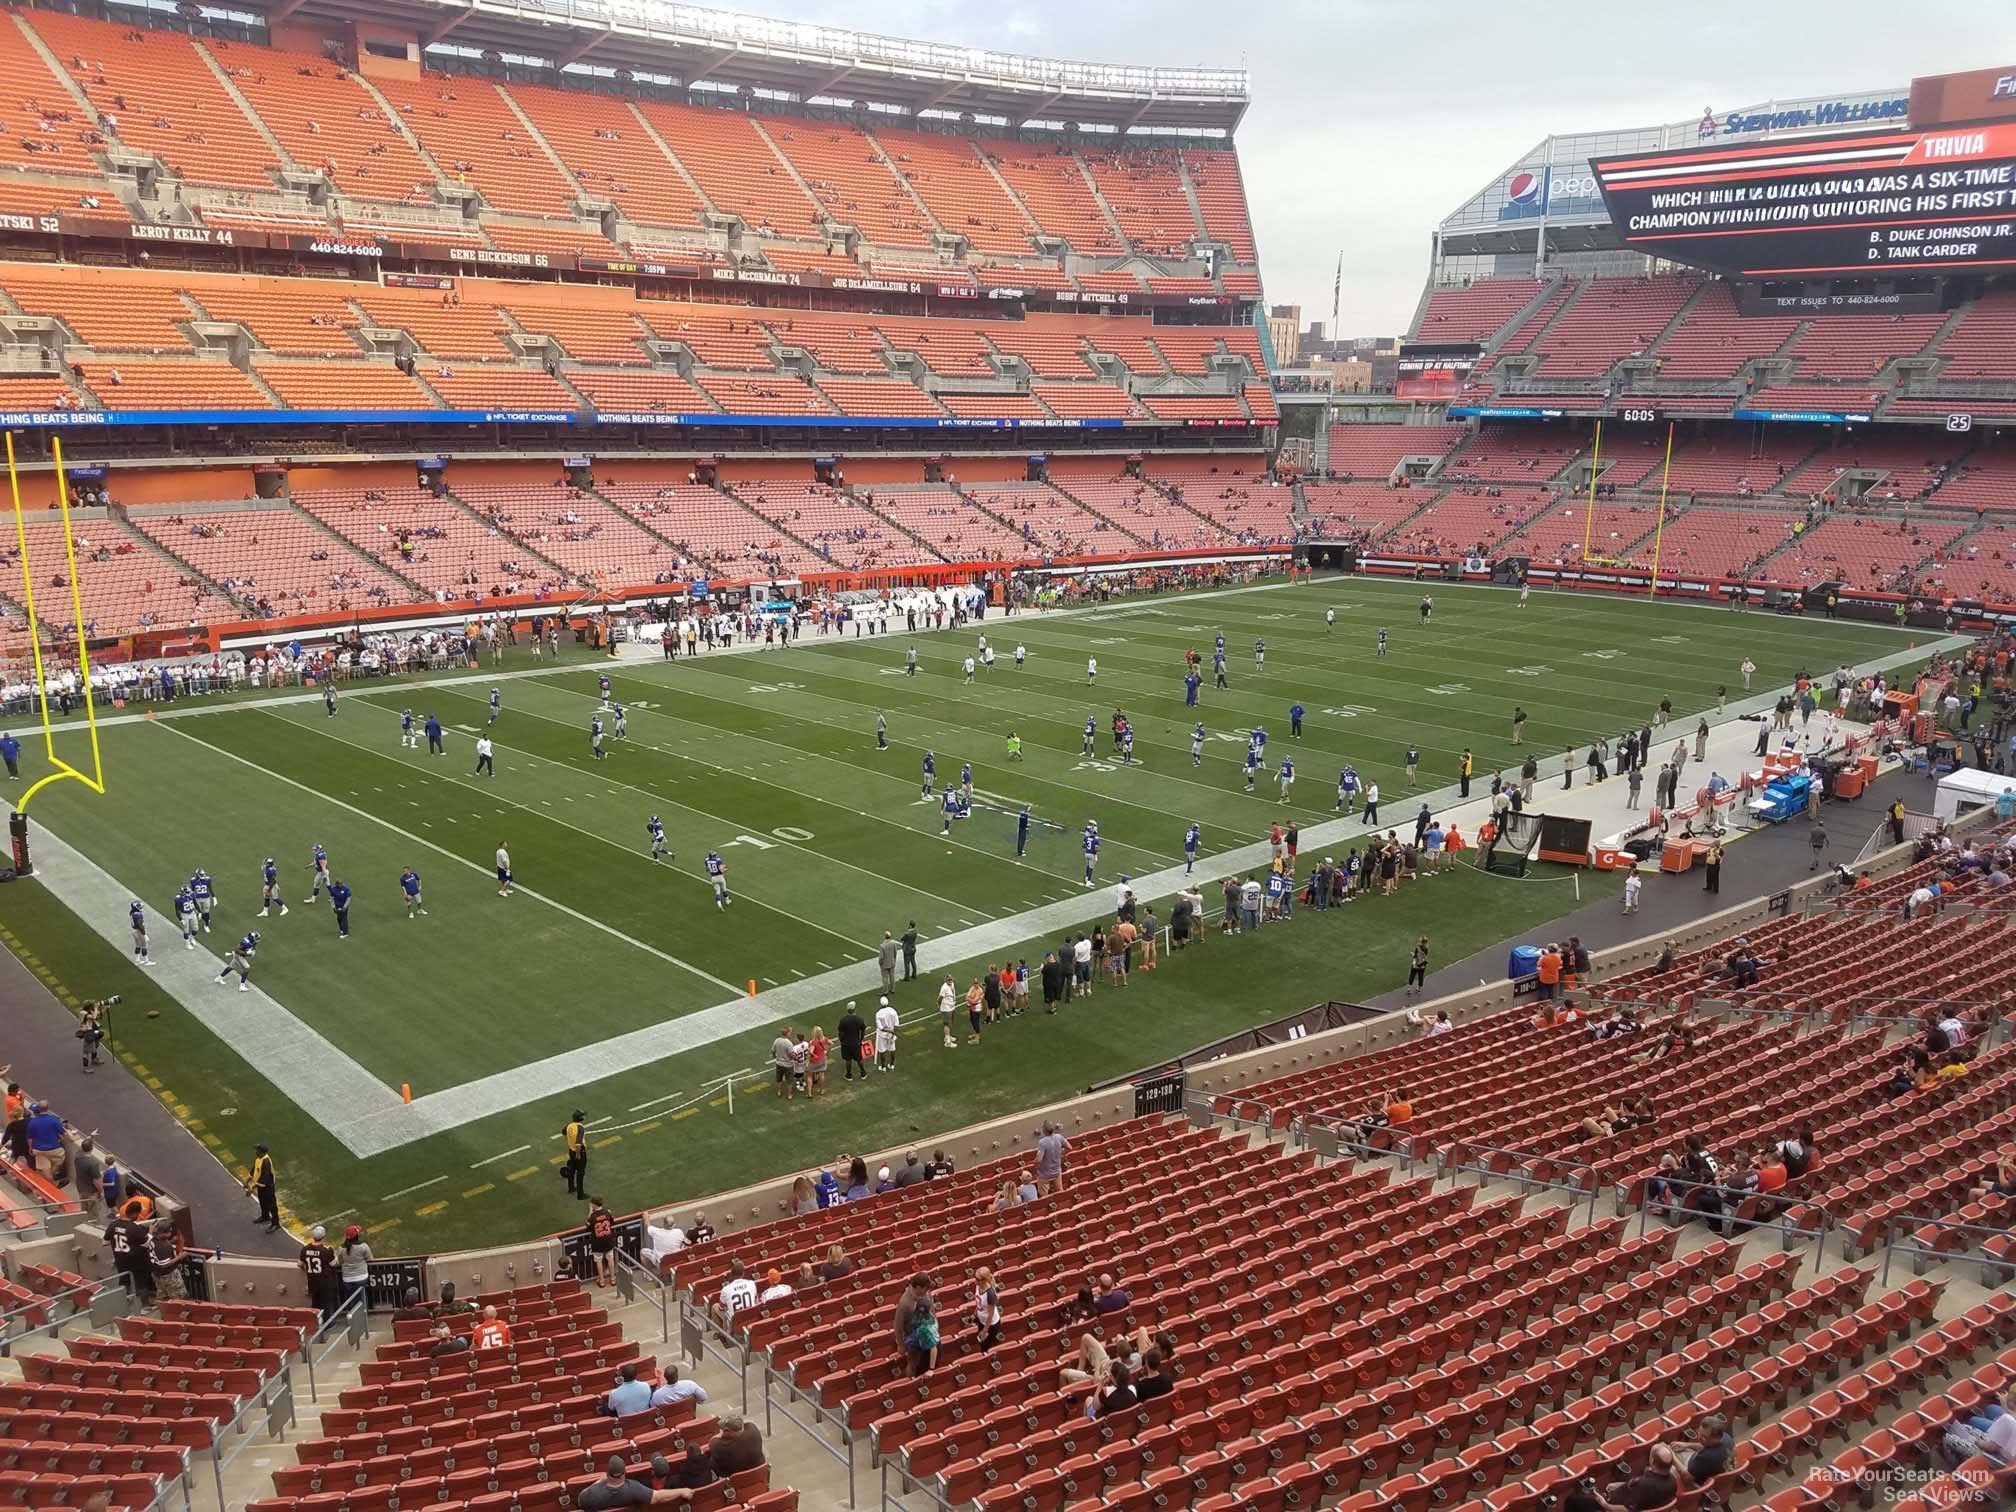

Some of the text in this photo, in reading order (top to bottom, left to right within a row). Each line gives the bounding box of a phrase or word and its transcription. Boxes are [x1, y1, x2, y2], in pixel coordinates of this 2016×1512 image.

[1924, 134, 1985, 158] TRIVIA
[1651, 191, 1701, 209] WHICH
[1911, 173, 1925, 190] A
[1928, 166, 2011, 188] SIX-TIME
[1629, 211, 1711, 230] CHAMPION
[1916, 194, 1947, 211] HIS
[1952, 190, 2006, 209] FIRST
[40, 217, 60, 231] 52
[131, 225, 233, 244] LEROY KELLY 44
[1870, 224, 2013, 243] B. DUKE JOHNSON JR.
[310, 243, 382, 257] 440-824-6000
[450, 249, 548, 266] GENE HICKERSON 66
[1868, 243, 1977, 259] D. TANK CARDER
[713, 269, 735, 280] MIKE
[789, 274, 800, 285] 74
[833, 277, 847, 288] JOE
[1777, 297, 1796, 306] TEXT
[1832, 296, 1843, 304] TO
[33, 412, 68, 424] BEATS
[71, 412, 104, 424] BEING
[507, 413, 529, 421] TICKET
[598, 414, 678, 424] NOTHING BEATS BEING
[1624, 408, 1655, 422] 60:05
[1950, 416, 1968, 429] 25
[735, 827, 815, 850] 10
[1603, 853, 1615, 864] G
[195, 885, 208, 894] 22
[1270, 880, 1281, 891] 10
[113, 1234, 131, 1252] 16
[306, 1257, 322, 1274] 13
[731, 1291, 752, 1312] 20
[481, 1333, 503, 1350] 45
